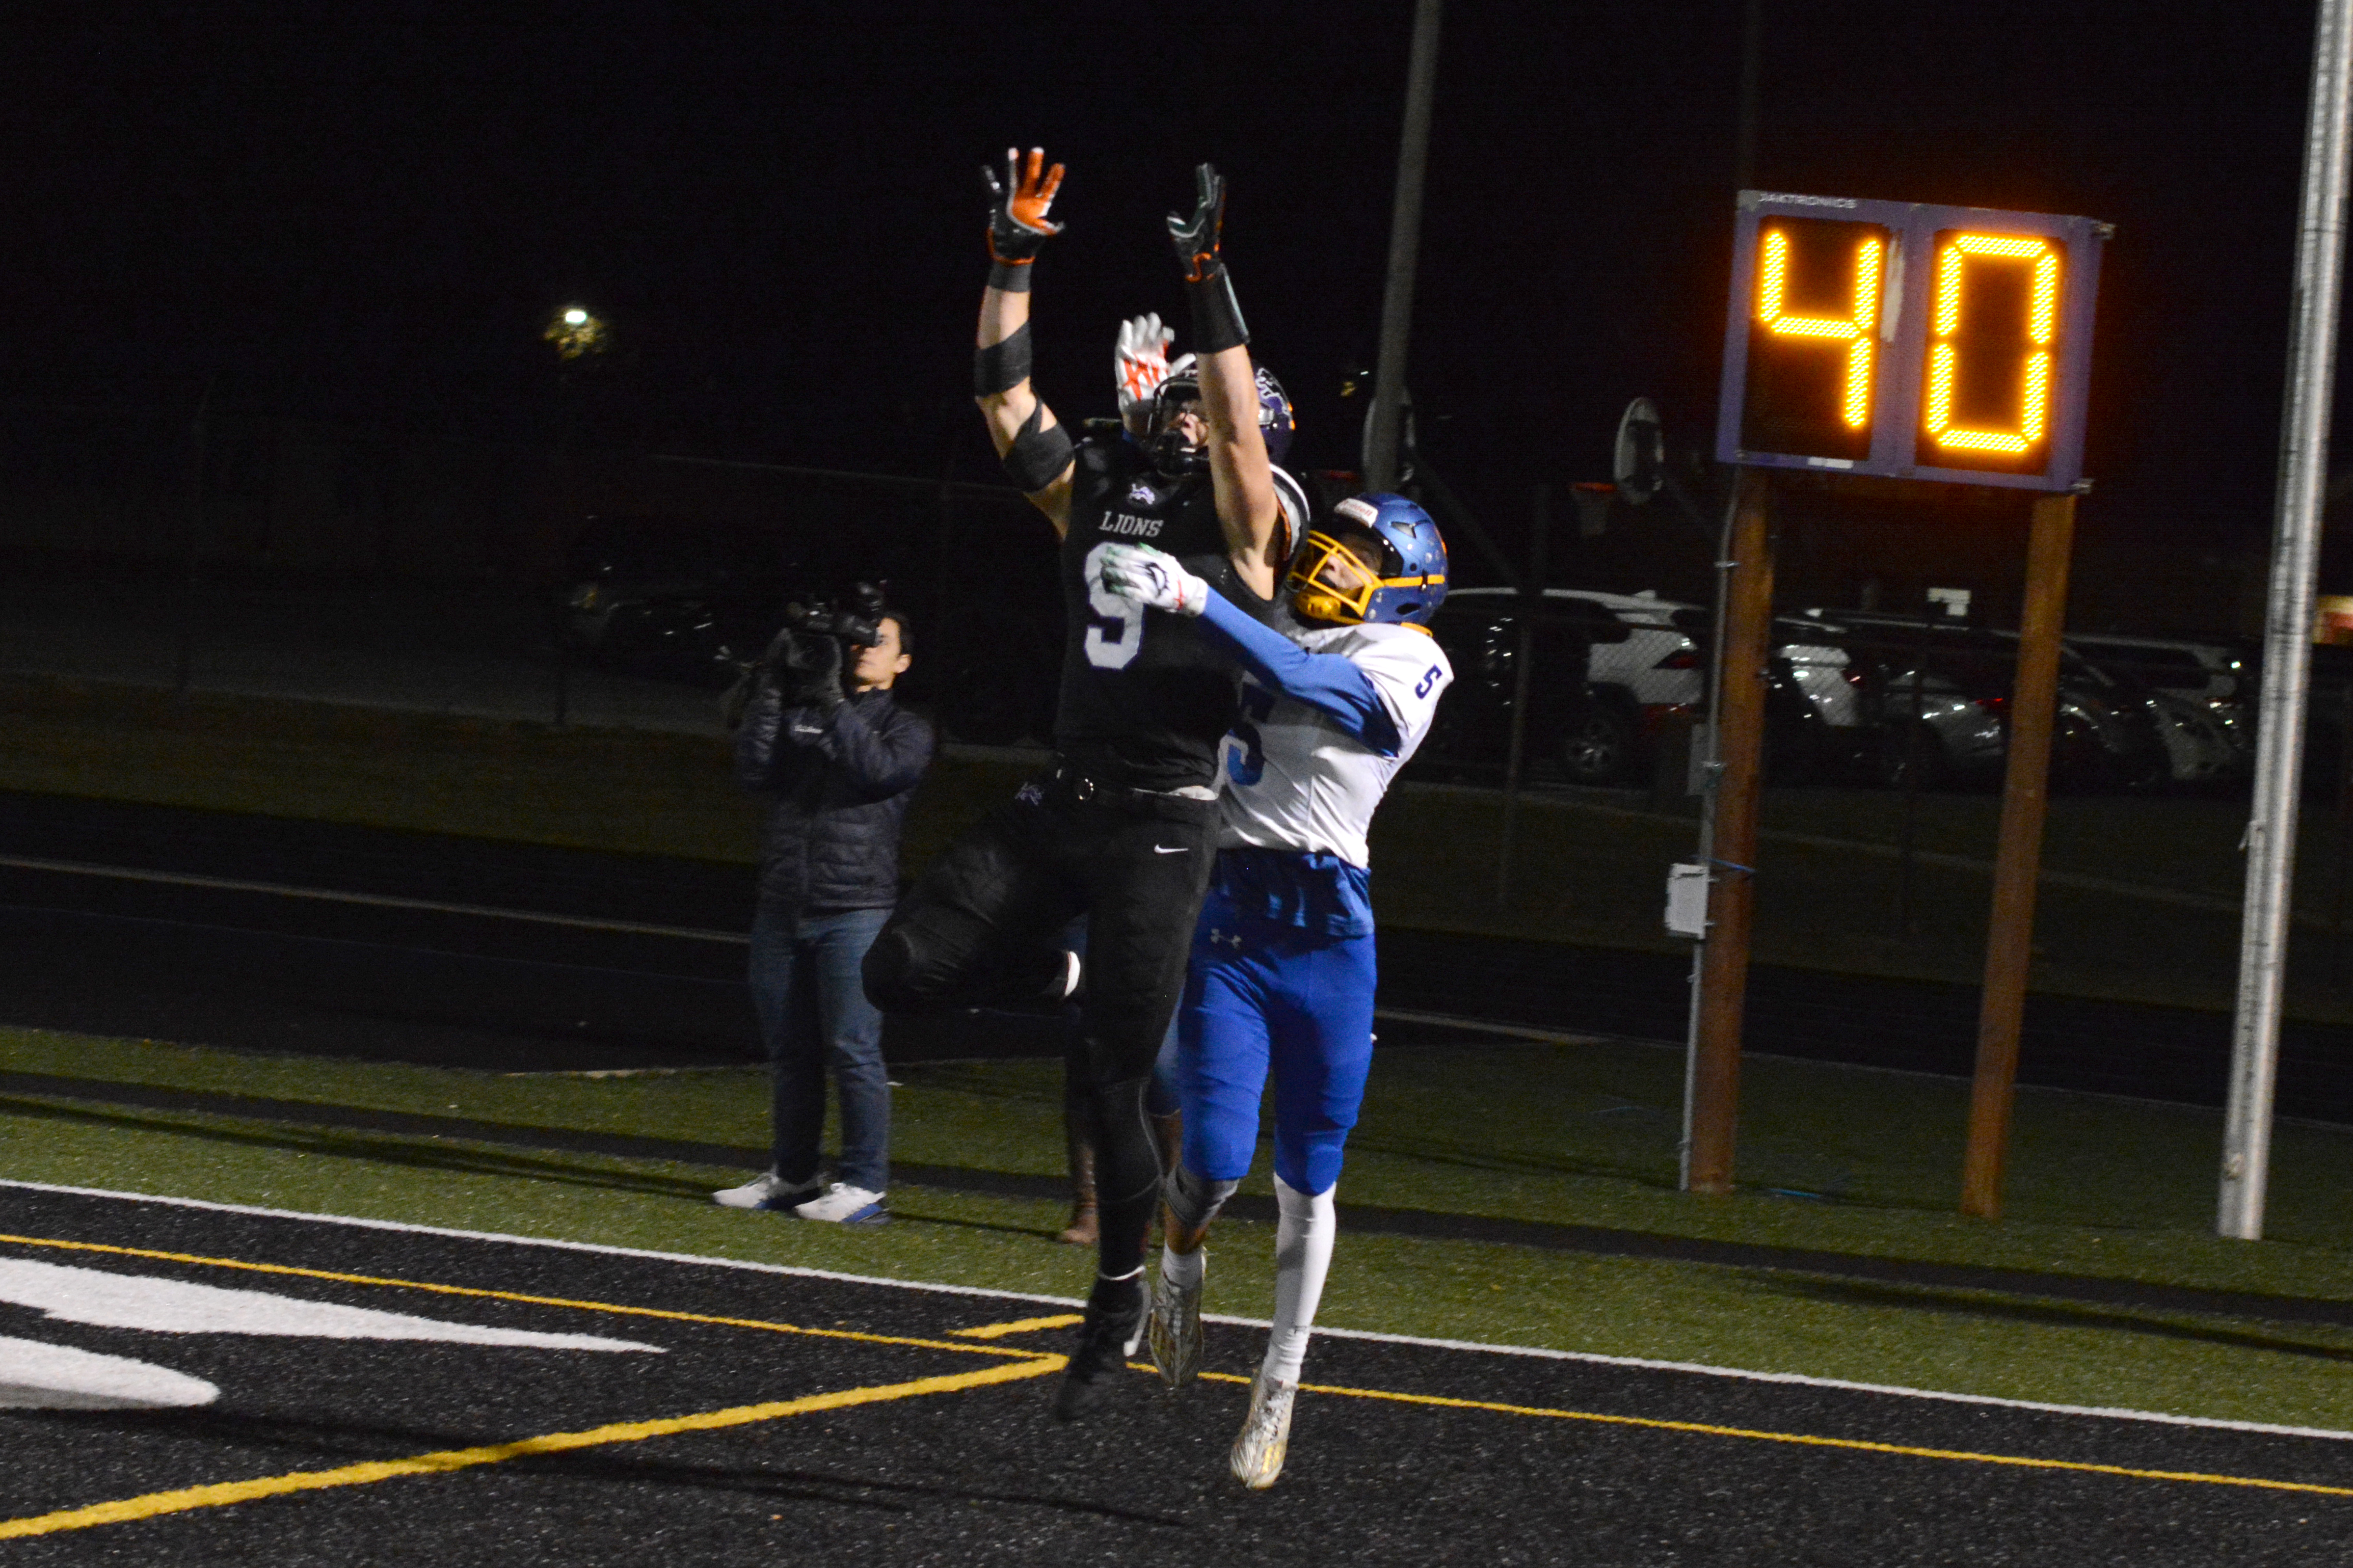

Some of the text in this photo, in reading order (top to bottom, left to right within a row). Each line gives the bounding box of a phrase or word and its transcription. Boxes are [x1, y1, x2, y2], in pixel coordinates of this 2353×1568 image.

[1760, 232, 2057, 452] 40
[1098, 511, 1164, 538] LIONS
[1084, 541, 1145, 670] 9
[1414, 663, 1442, 700] 5
